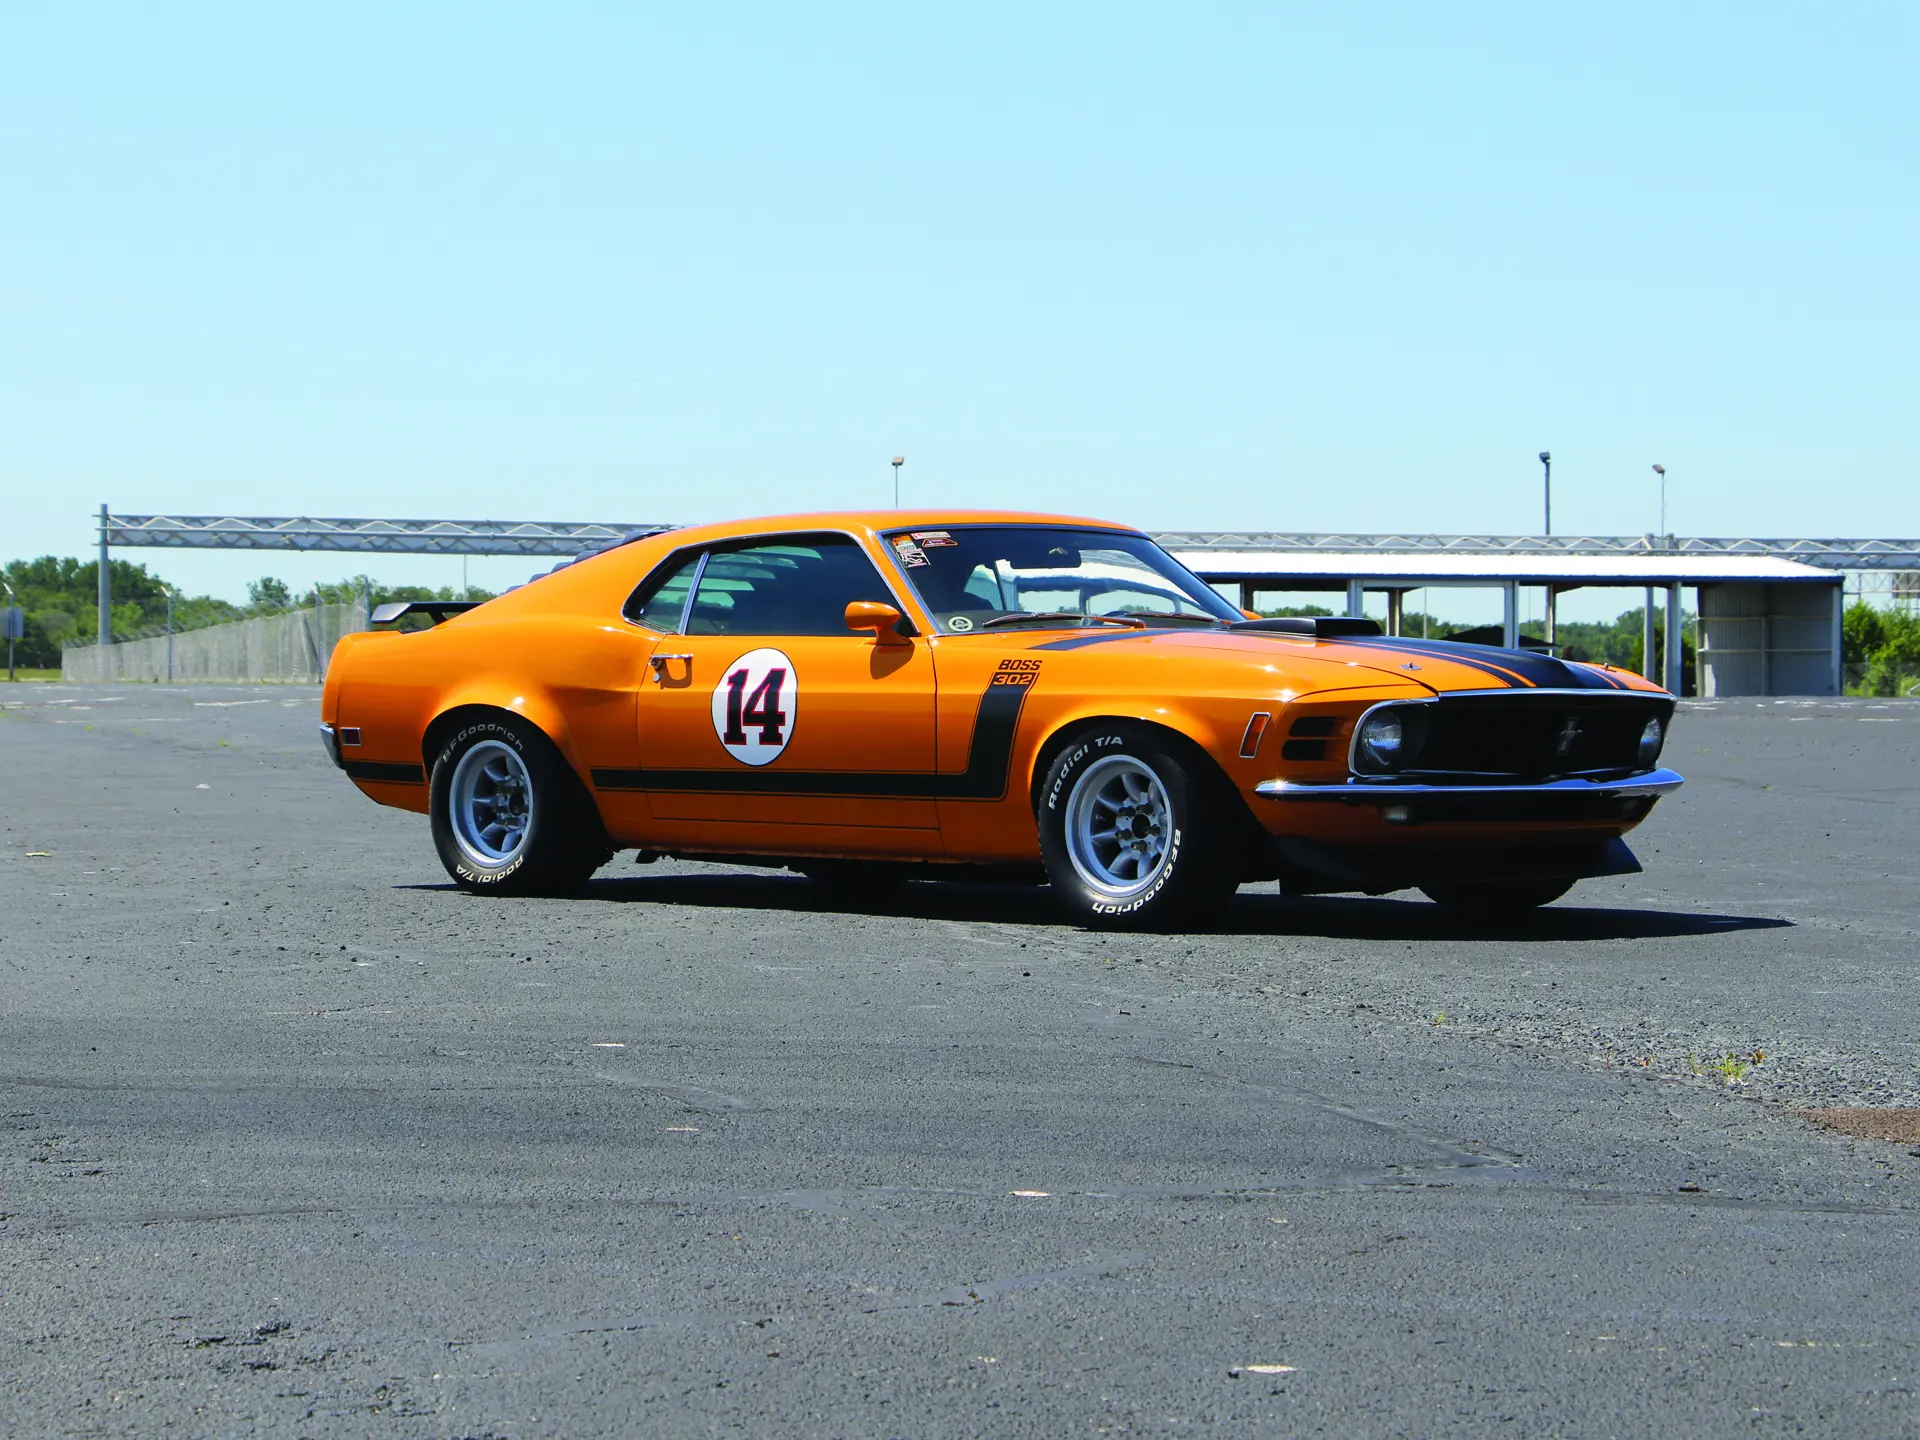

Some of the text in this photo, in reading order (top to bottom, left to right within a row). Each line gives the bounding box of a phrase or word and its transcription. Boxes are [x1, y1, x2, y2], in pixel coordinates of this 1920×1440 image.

[993, 674, 1033, 685] 302
[998, 659, 1043, 671] BOSS
[723, 668, 787, 746] 14
[442, 723, 523, 762] BFGoodrich
[1048, 736, 1123, 810] Radial T/A
[456, 854, 524, 883] Radial T/A
[1092, 828, 1181, 915] BFGoodrich
